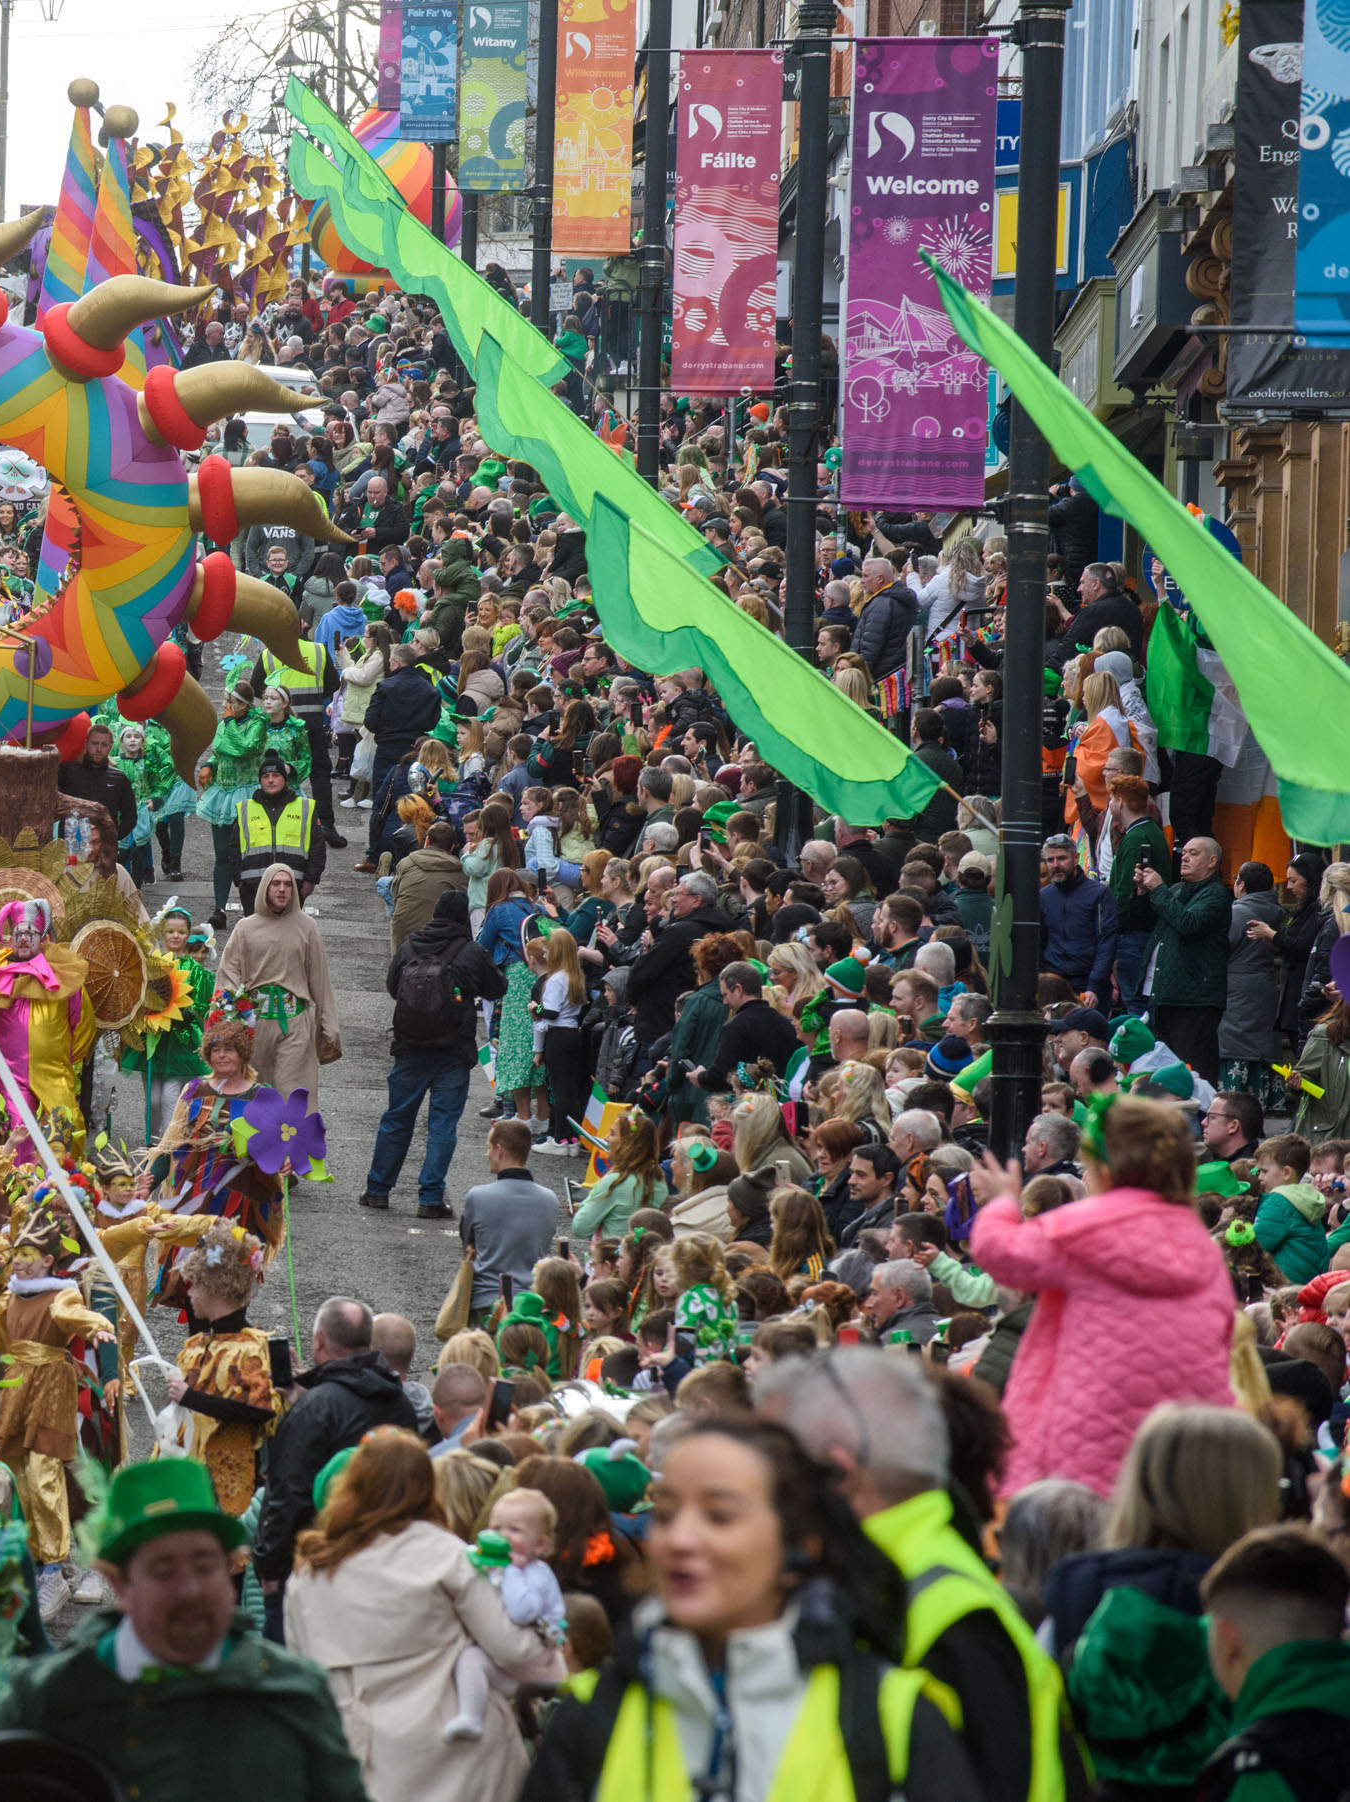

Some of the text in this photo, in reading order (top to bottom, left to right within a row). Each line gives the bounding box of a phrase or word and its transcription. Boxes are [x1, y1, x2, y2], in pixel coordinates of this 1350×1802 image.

[407, 9, 424, 17] Fair
[441, 9, 452, 17] Ye
[473, 37, 517, 48] Witamy
[565, 67, 627, 78] Willkommen
[996, 136, 1019, 150] TY
[701, 152, 756, 169] Fáilte
[866, 175, 980, 195] Welcome
[682, 362, 764, 370] derrystrabane.com
[858, 458, 969, 469] derrystrabane.com
[263, 526, 296, 539] VANS
